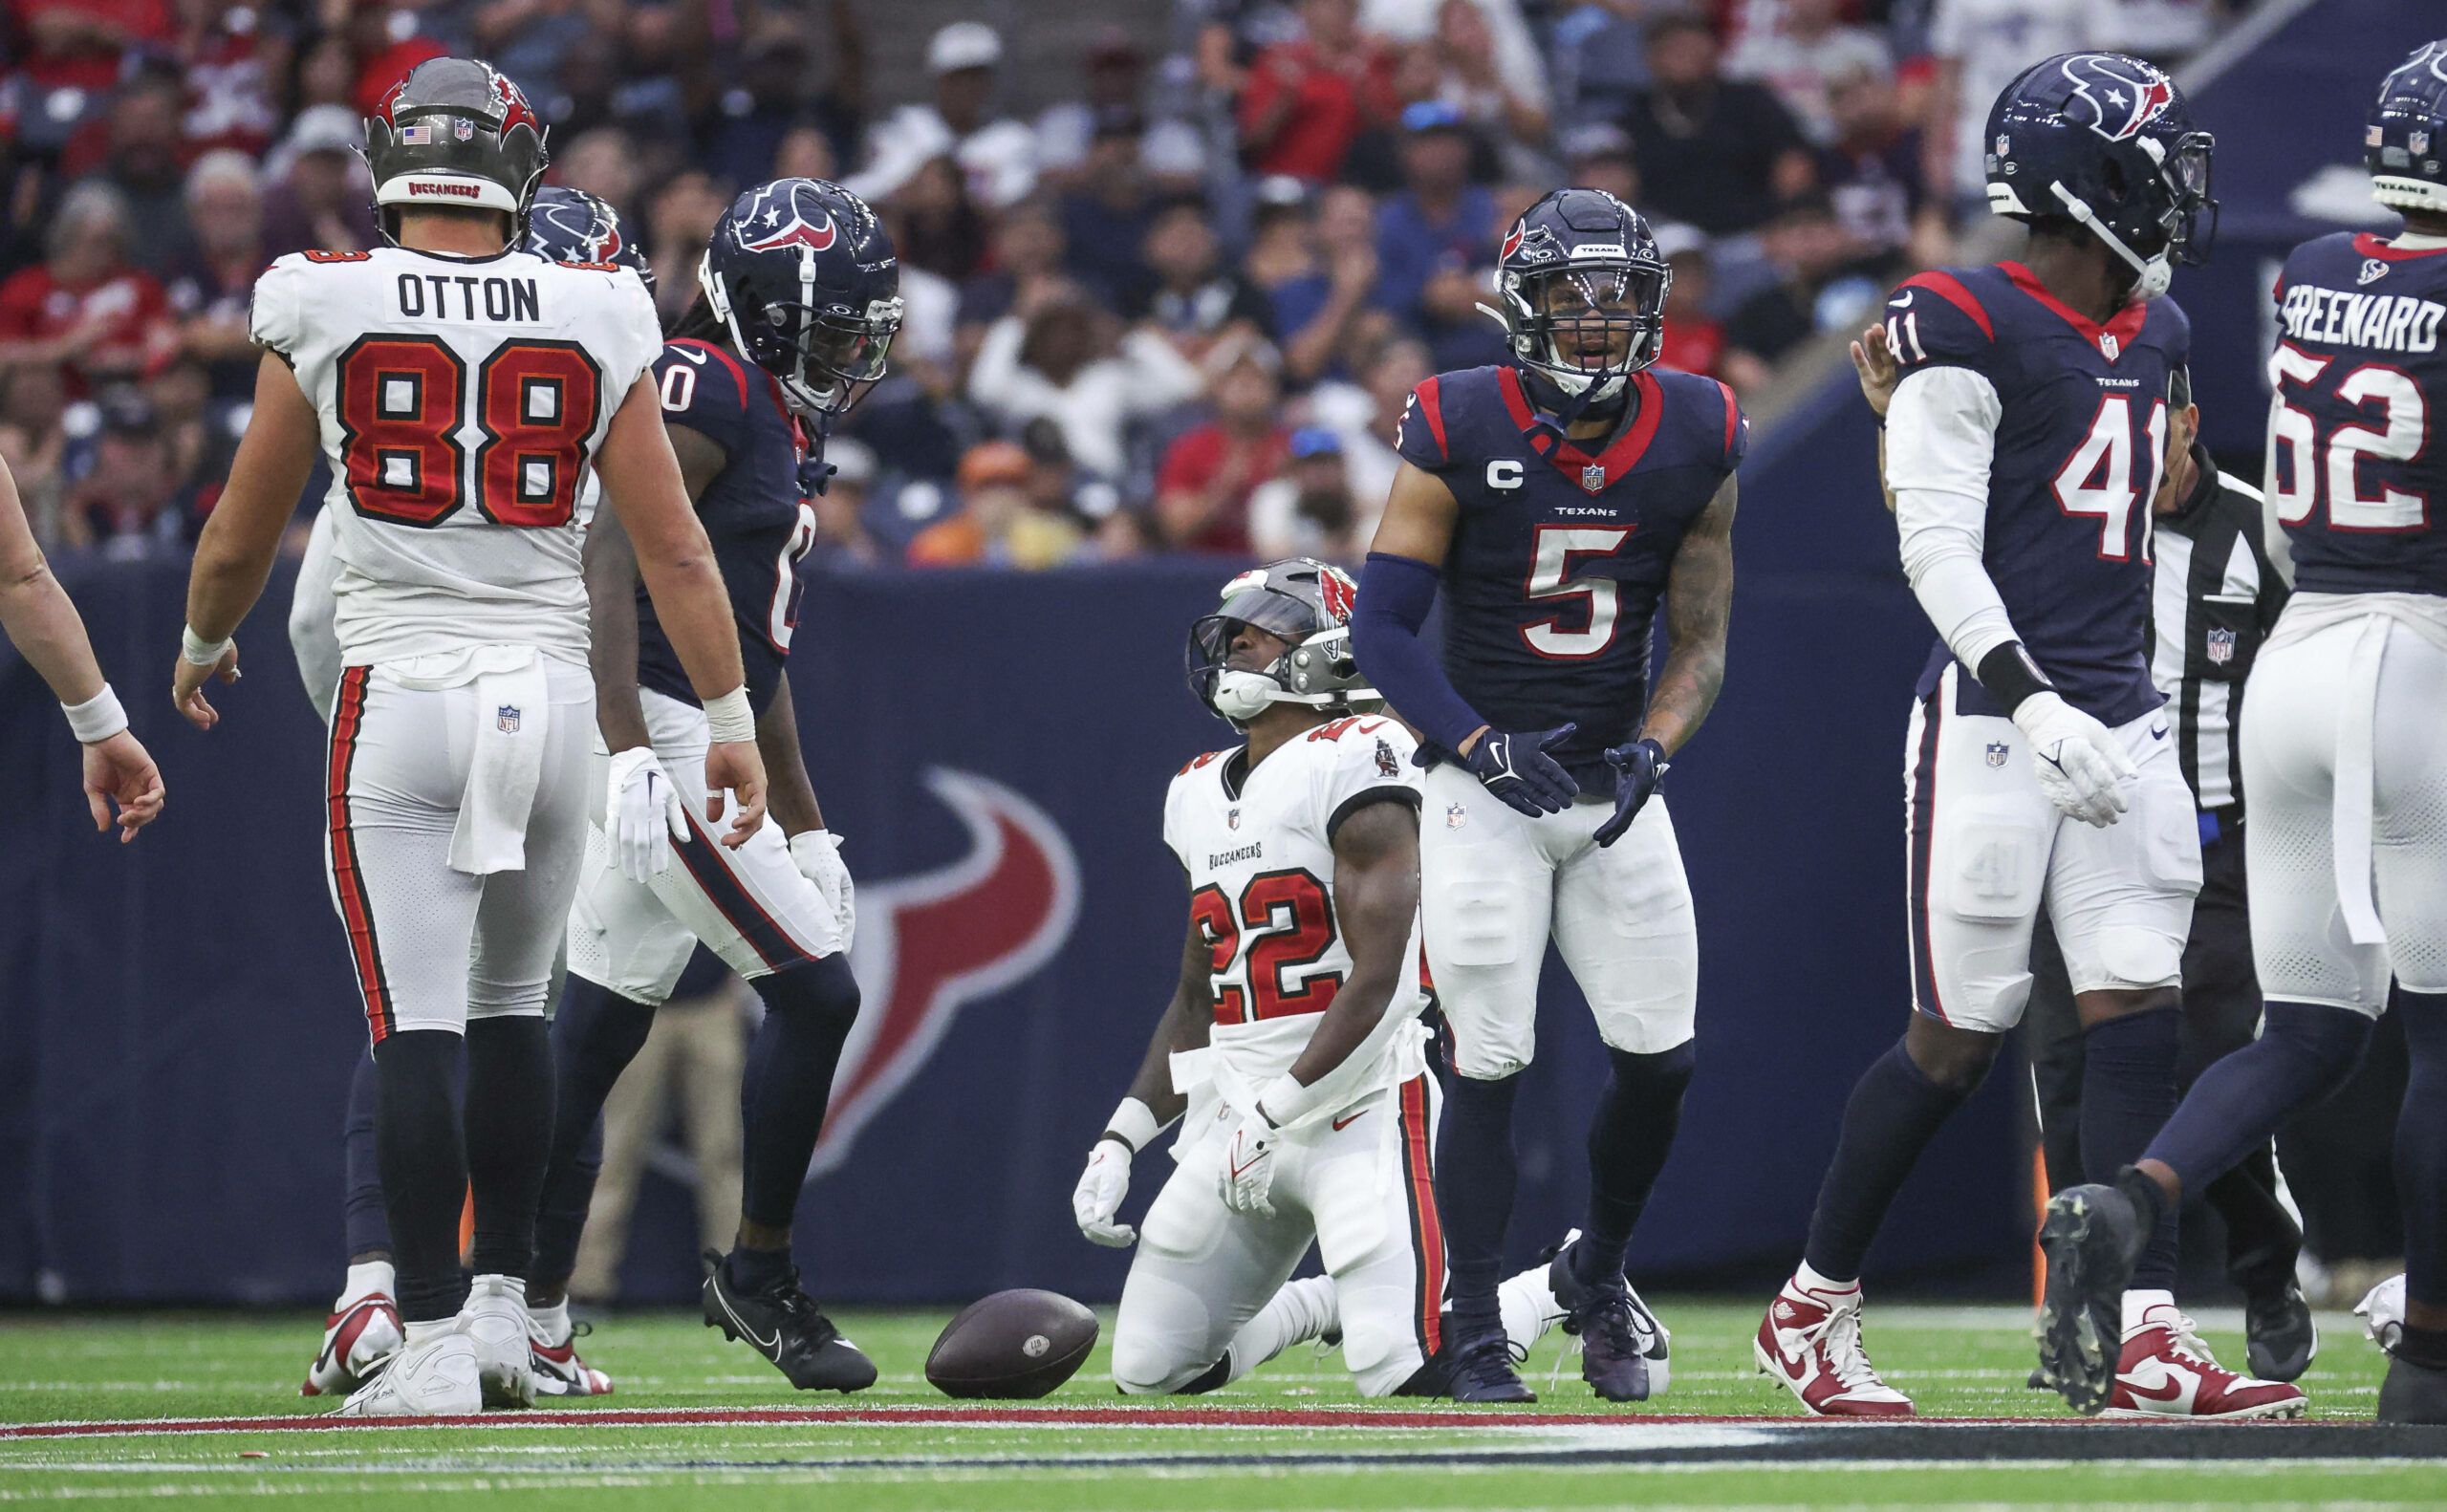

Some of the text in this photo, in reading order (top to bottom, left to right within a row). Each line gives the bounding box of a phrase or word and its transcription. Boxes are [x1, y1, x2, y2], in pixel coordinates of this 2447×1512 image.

[456, 127, 471, 138] NFL
[408, 182, 481, 199] BUCCANEERS
[398, 273, 540, 322] OTTON
[1885, 312, 1928, 364] 41
[660, 363, 696, 413] 0
[2094, 378, 2140, 387] TEXANS
[336, 332, 603, 529] 88
[1486, 460, 1524, 489] C
[1584, 476, 1602, 487] NFL
[2048, 393, 2168, 567] 41
[1554, 507, 1618, 517] TEXANS
[1518, 523, 1638, 661] 5
[498, 716, 519, 731] NFL
[1209, 841, 1262, 871] BUCCANEERS
[1192, 867, 1344, 1026] 22
